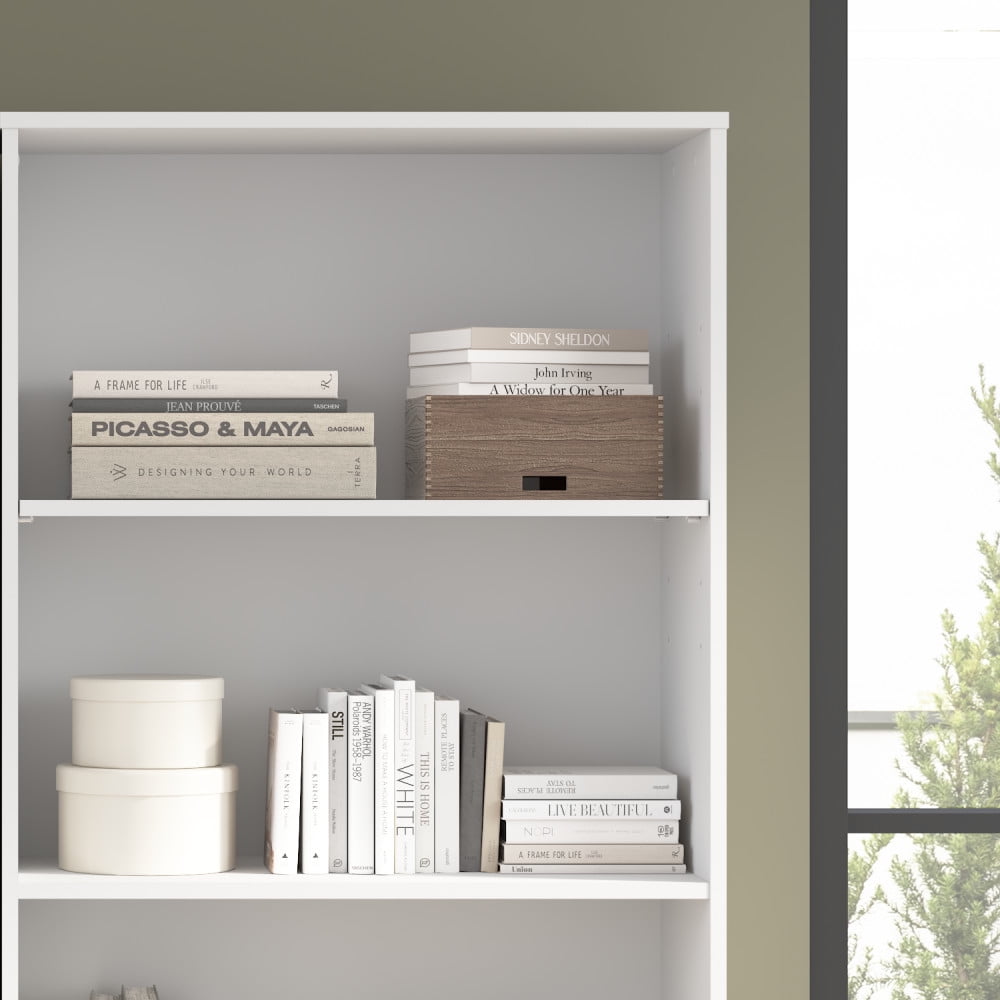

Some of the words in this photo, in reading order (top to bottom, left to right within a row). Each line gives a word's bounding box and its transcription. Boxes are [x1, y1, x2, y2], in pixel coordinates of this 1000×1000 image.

[509, 332, 551, 345] SIDNEY
[554, 333, 610, 346] SHELDON
[534, 366, 558, 380] John
[561, 368, 592, 380] Irving
[94, 380, 100, 390] A
[106, 380, 140, 390] FRAME
[144, 380, 162, 390] FOR
[167, 380, 187, 390] LIFE
[490, 384, 498, 395] A
[503, 384, 546, 396] Widow
[550, 384, 566, 396] for
[569, 385, 595, 396] One
[598, 386, 624, 396] Year
[166, 402, 193, 412] JEAN
[196, 400, 242, 411] PROUVÉ
[91, 421, 209, 437] PICASSO
[217, 421, 237, 437] &
[244, 421, 314, 437] MAYA
[138, 468, 212, 476] DESIGNING
[221, 468, 255, 476] YOUR
[266, 468, 312, 476] WORLD
[352, 702, 361, 737] Polaroids
[361, 702, 372, 723] ANDY
[331, 711, 344, 740] STILL
[361, 724, 372, 760] WARHOL
[420, 752, 430, 777] THIS
[448, 762, 454, 771] TO
[420, 781, 430, 791] IS
[396, 763, 414, 836] WHITE
[420, 794, 430, 826] HOME
[548, 803, 577, 816] LIVE
[581, 803, 652, 817] BEAUTIFUL
